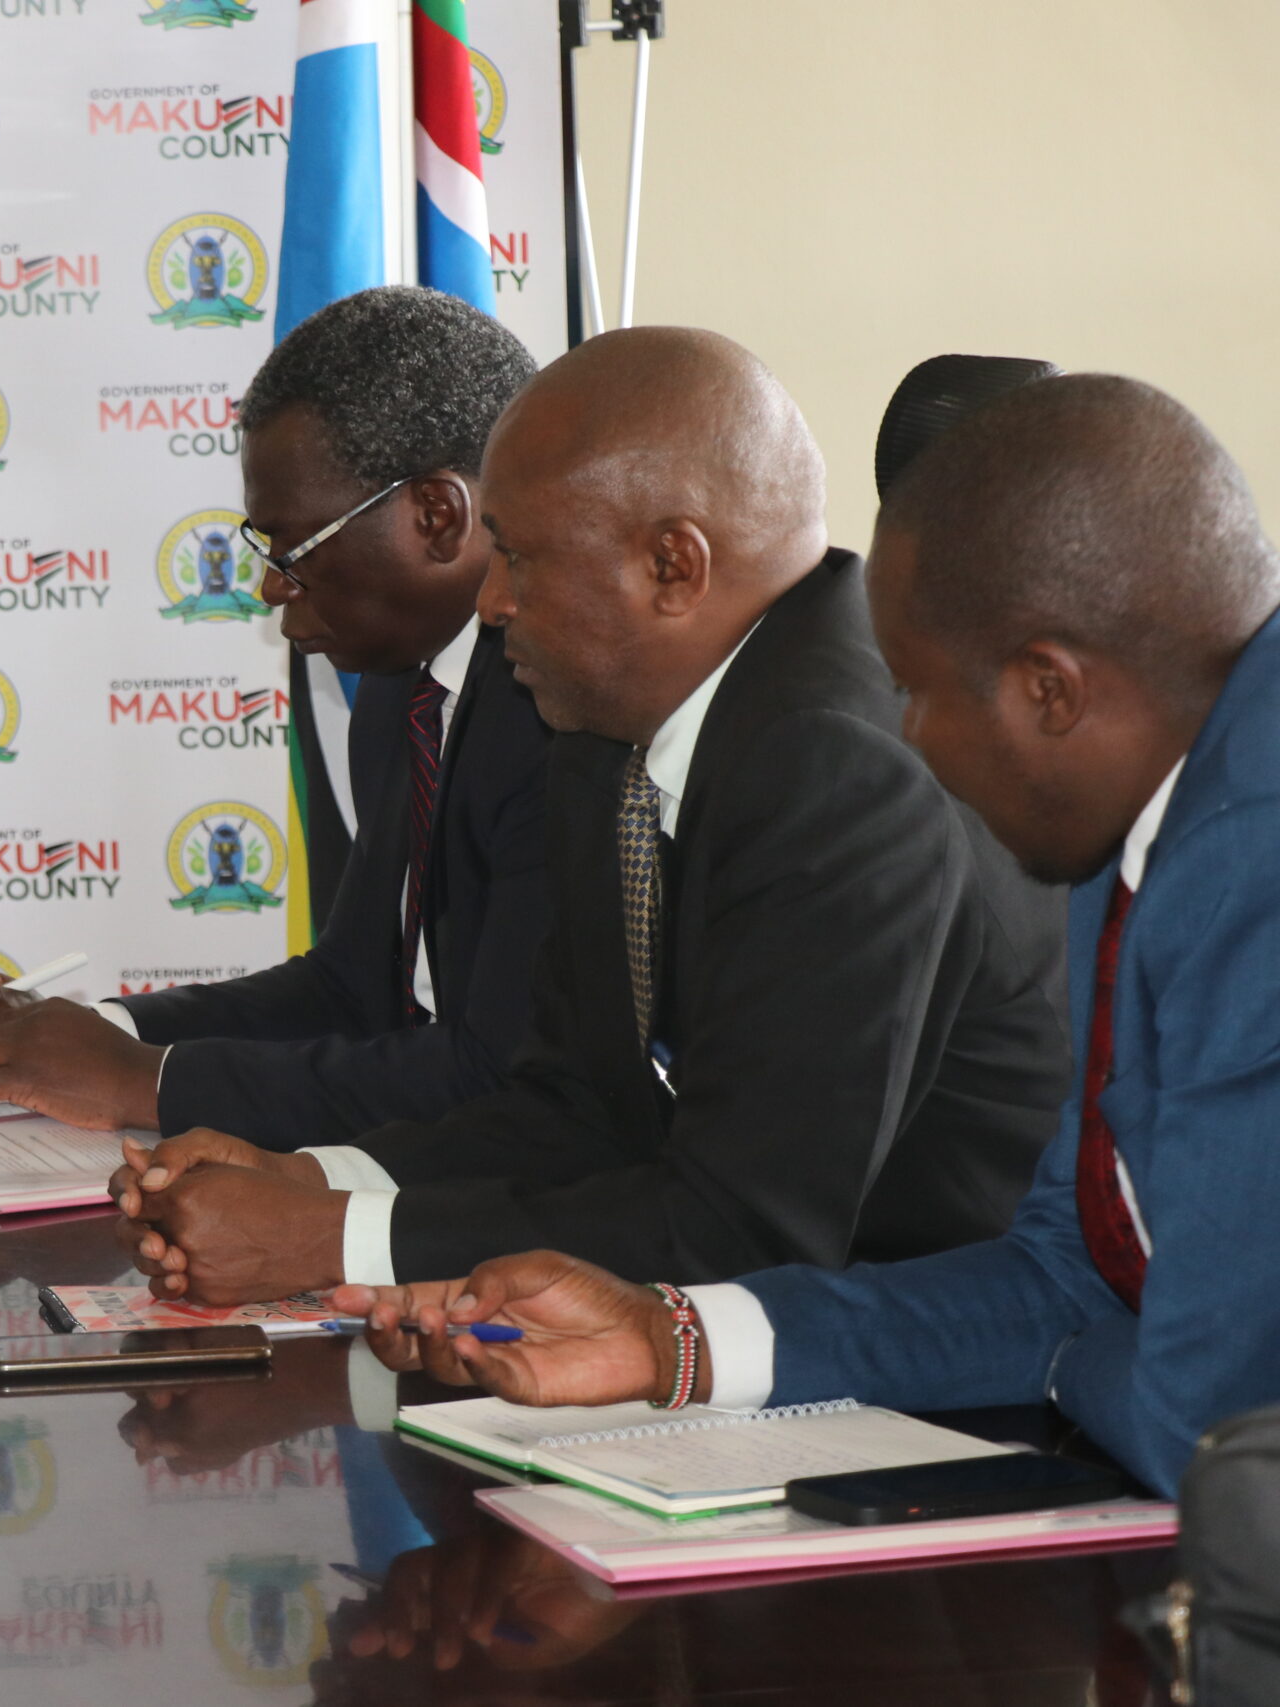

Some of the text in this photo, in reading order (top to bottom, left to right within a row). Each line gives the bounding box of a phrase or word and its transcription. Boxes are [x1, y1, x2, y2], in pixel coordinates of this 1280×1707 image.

[90, 84, 220, 100] GOVERNMENT OF
[88, 95, 291, 134] MAKUEN
[0, 244, 20, 255] OF
[100, 382, 229, 398] GOVERNMENT OF
[99, 397, 240, 432] MAKU
[169, 432, 240, 457] COU
[11, 538, 30, 550] OF
[110, 676, 238, 691] GOVERNMENT OF
[109, 689, 289, 725] MAKUEN
[178, 720, 288, 749] COUNT
[22, 828, 42, 840] OF
[121, 966, 248, 981] GOVERNMENT OF
